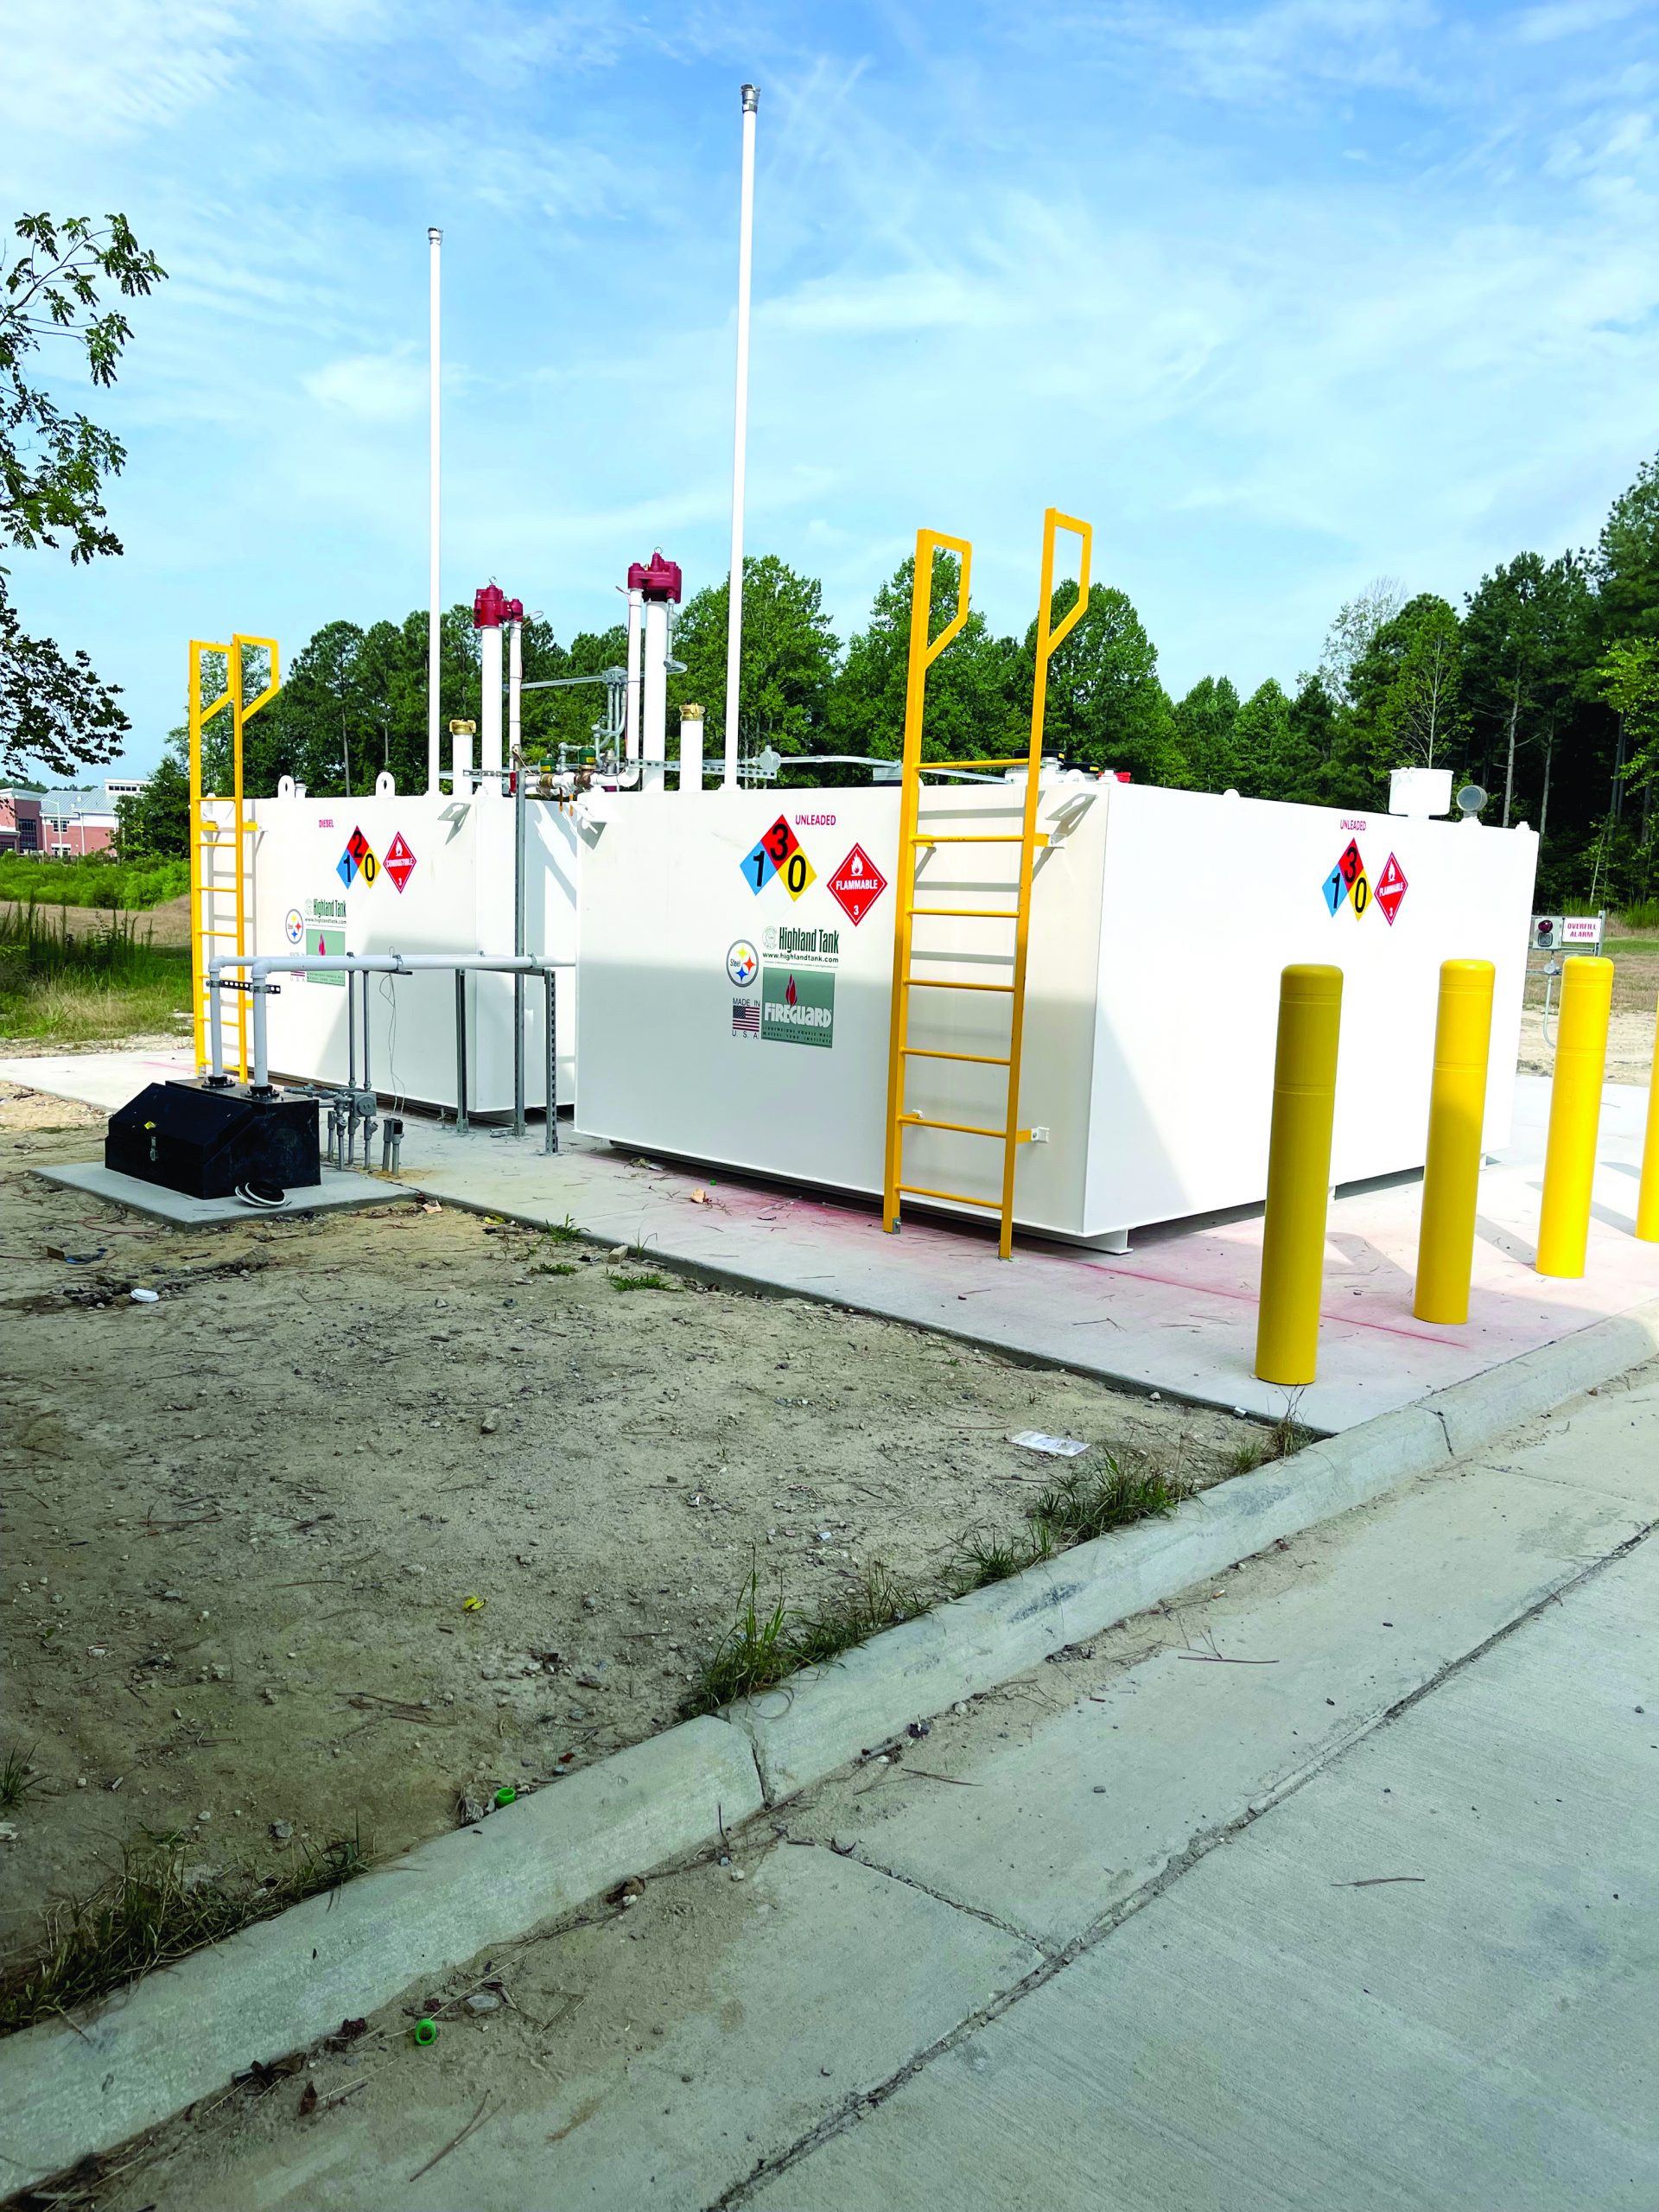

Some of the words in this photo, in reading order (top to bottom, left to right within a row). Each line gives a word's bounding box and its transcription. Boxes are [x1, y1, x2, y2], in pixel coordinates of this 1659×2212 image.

[319, 819, 334, 828] DIESEL
[795, 815, 836, 826] UNLEADED
[1340, 819, 1366, 830] UNLEADED
[353, 830, 363, 858] 2
[770, 823, 789, 861] 3
[343, 855, 352, 882] 1
[365, 853, 375, 881] 0
[753, 850, 765, 887] 1
[787, 855, 807, 893] 0
[1344, 847, 1357, 883] 3
[836, 880, 878, 891] FLAMMABLE
[1332, 872, 1340, 909] 1
[1355, 877, 1367, 913] 0
[1379, 882, 1404, 897] FLAMMABLE
[335, 899, 346, 918] Tank
[853, 905, 859, 915] 3
[1389, 906, 1393, 917] 3
[779, 926, 817, 953] Highland
[819, 929, 839, 954] Tank
[763, 952, 839, 963] www.highlandtank.com
[733, 998, 751, 1007] MADE
